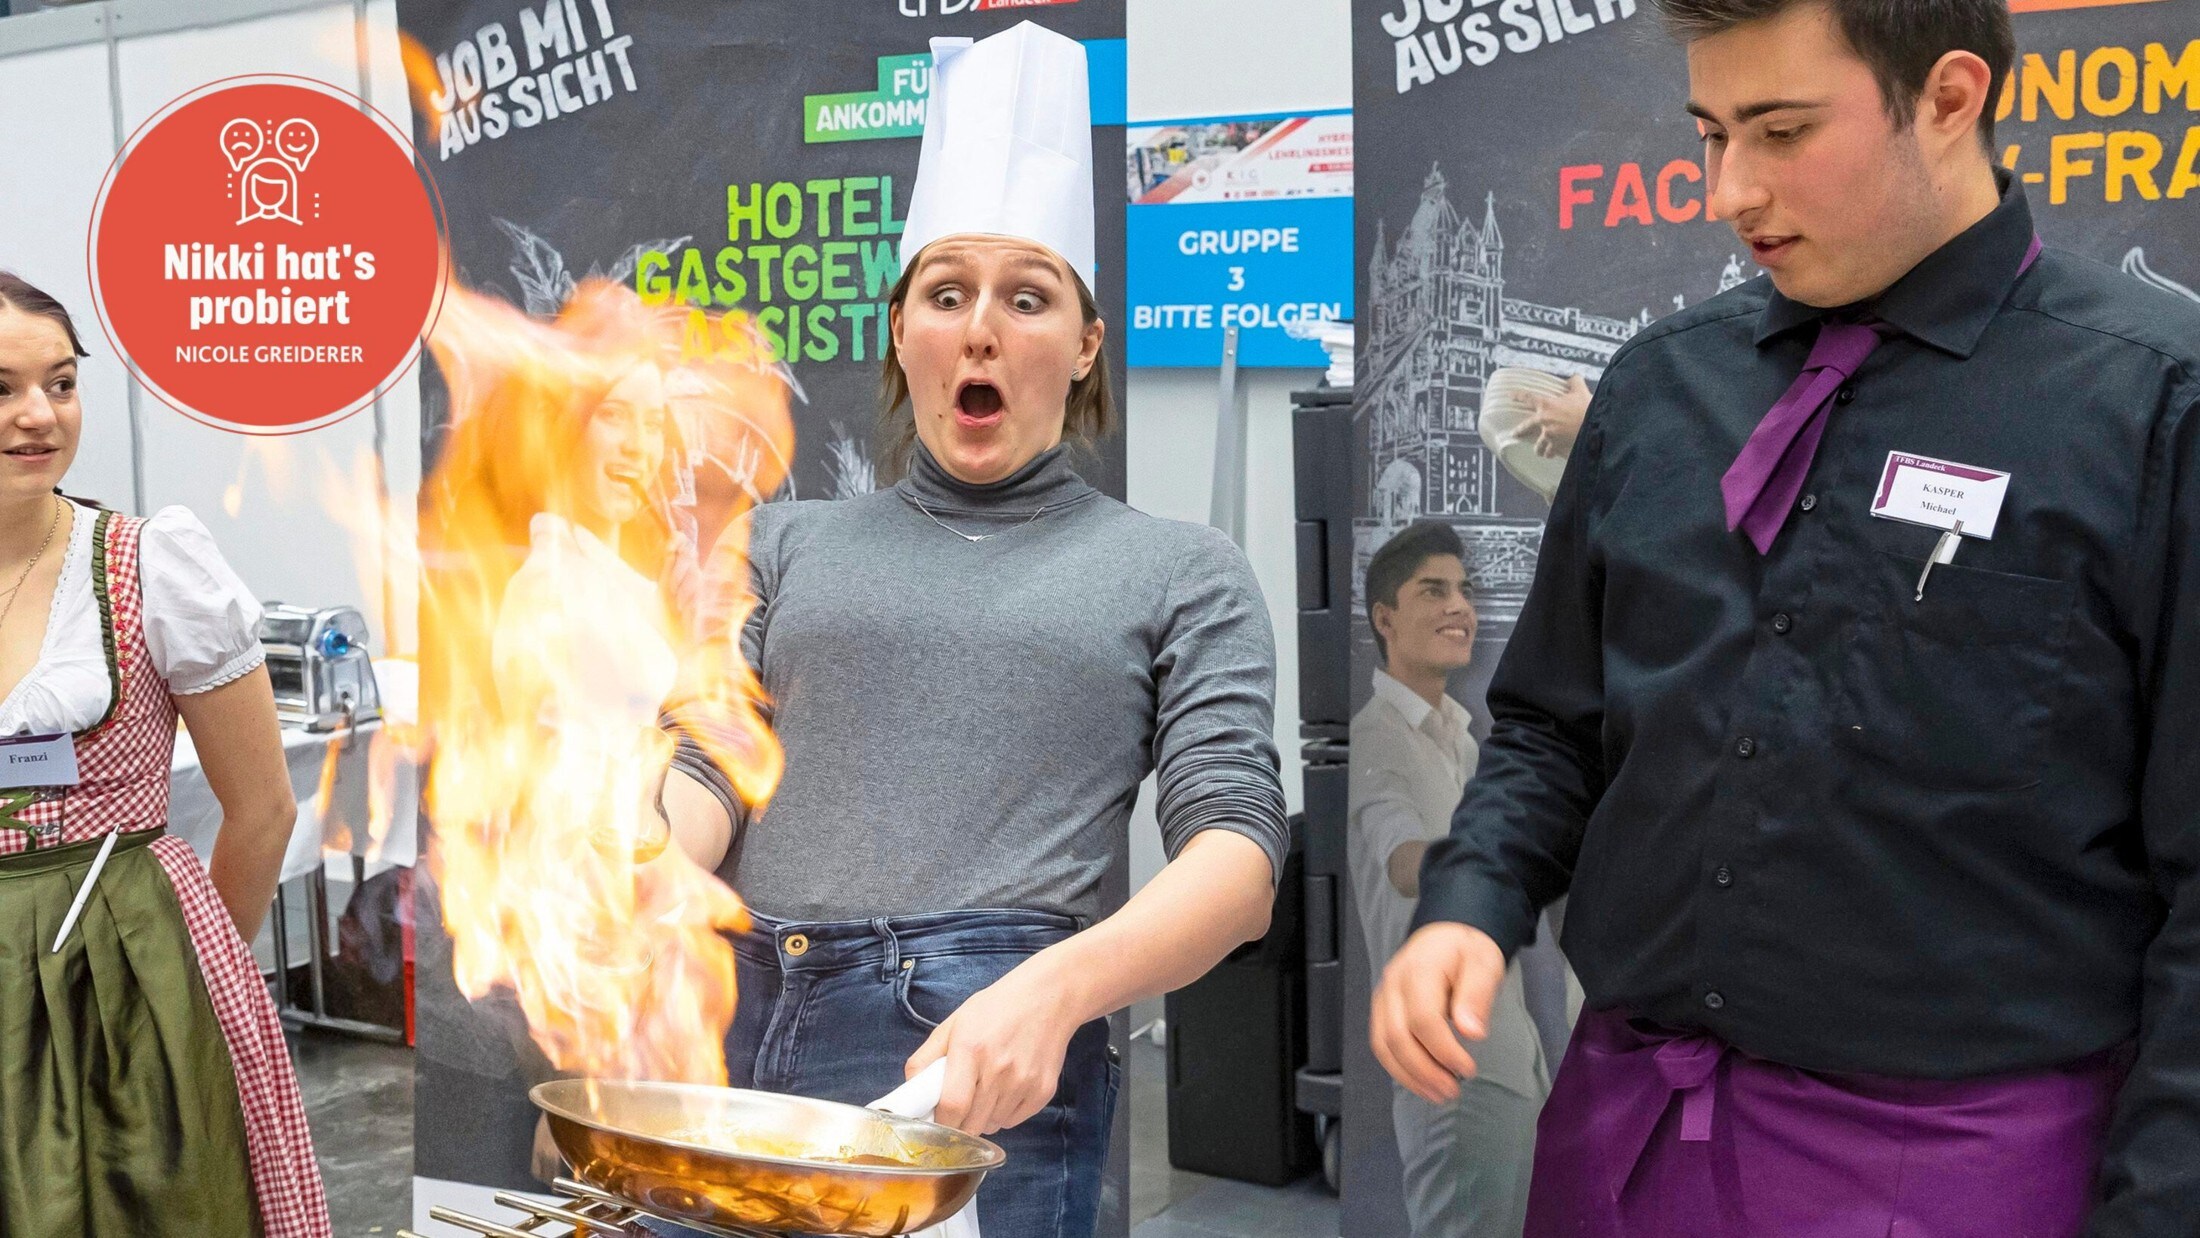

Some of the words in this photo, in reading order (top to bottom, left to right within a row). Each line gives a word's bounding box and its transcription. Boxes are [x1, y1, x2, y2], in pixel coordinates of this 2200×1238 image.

[430, 22, 518, 113] JOB
[893, 60, 936, 97] FÜ
[440, 34, 638, 162] AUSSICHT
[816, 98, 927, 132] ANKOMM
[2002, 125, 2200, 206] -FRA
[727, 175, 904, 242] HOTEL
[1558, 158, 1718, 230] FAC
[1178, 227, 1300, 255] GRUPPE
[1226, 266, 1246, 292] 3
[1133, 304, 1214, 330] BITTE
[1220, 302, 1342, 329] FOLGEN
[1895, 455, 1916, 466] TFBS
[1915, 459, 1947, 473] Landeck
[1922, 483, 1965, 499] KASPER
[1920, 500, 1957, 516] Michael
[9, 752, 49, 764] Franzi
